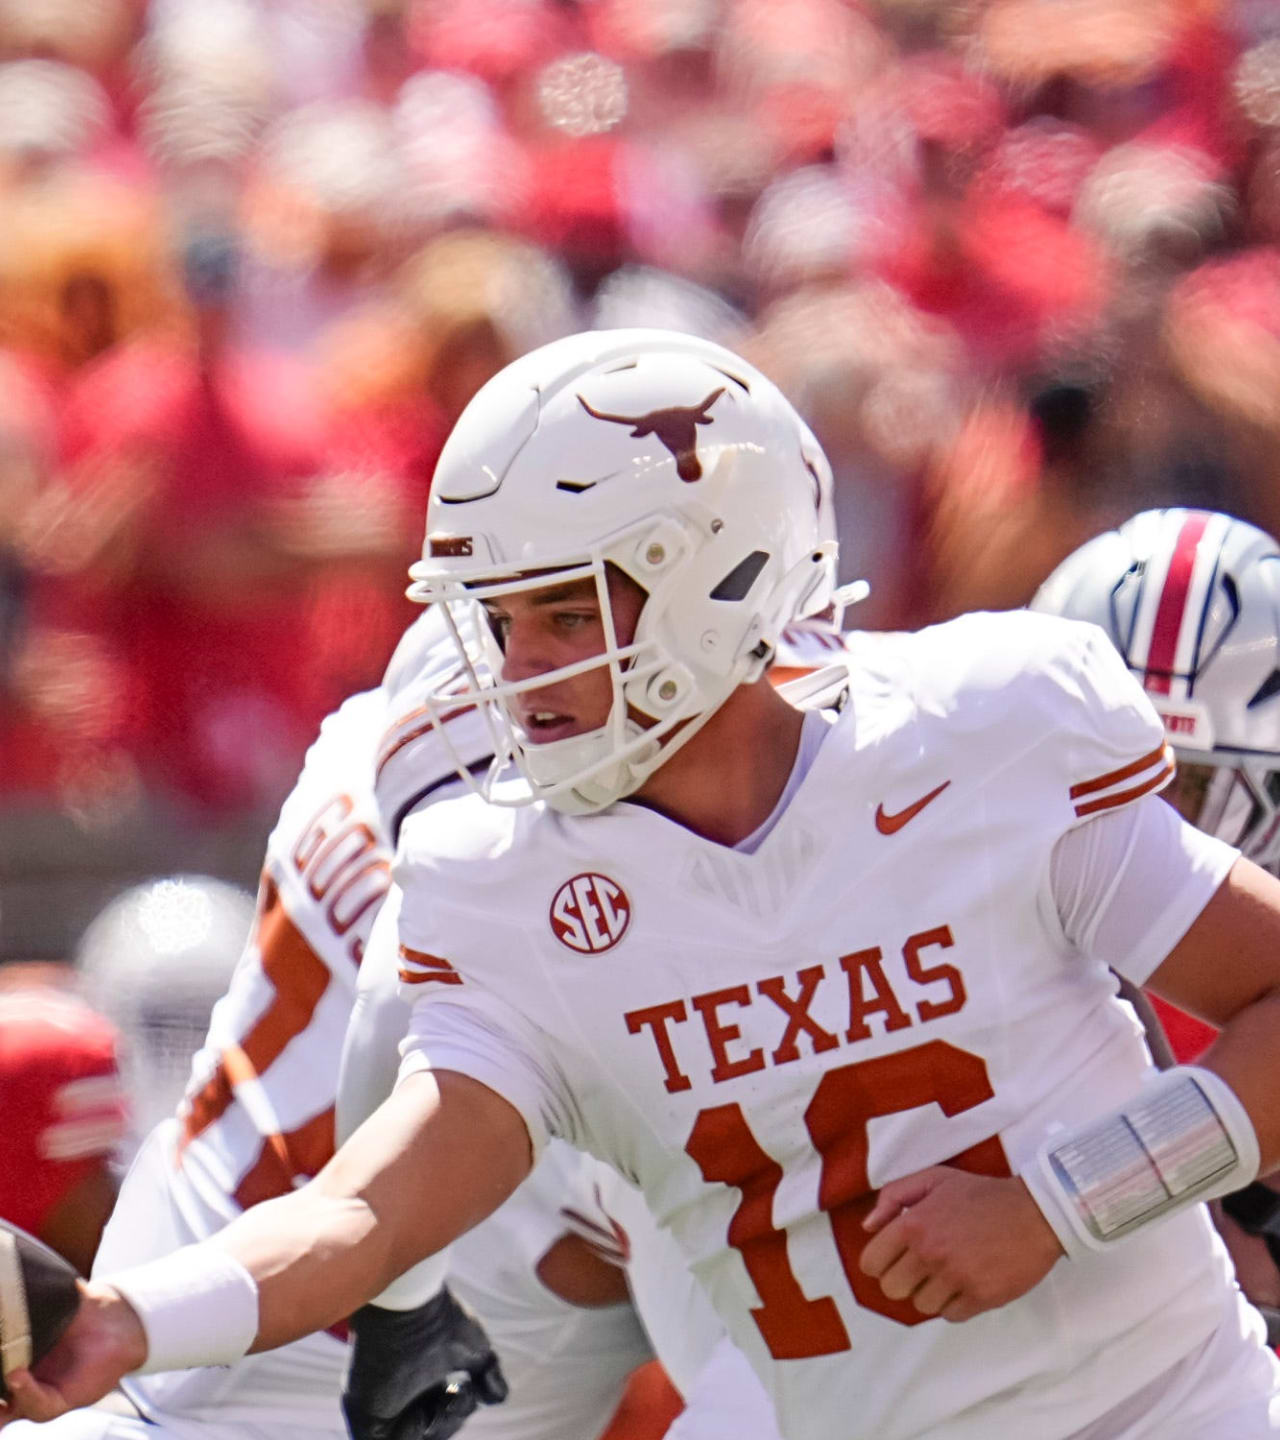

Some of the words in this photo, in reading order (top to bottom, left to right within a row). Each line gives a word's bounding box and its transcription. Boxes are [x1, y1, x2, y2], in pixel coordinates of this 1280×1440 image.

[294, 795, 393, 968] GOO
[549, 872, 631, 955] SEC
[625, 925, 967, 1094] TEXAS
[685, 1038, 1014, 1361] 16
